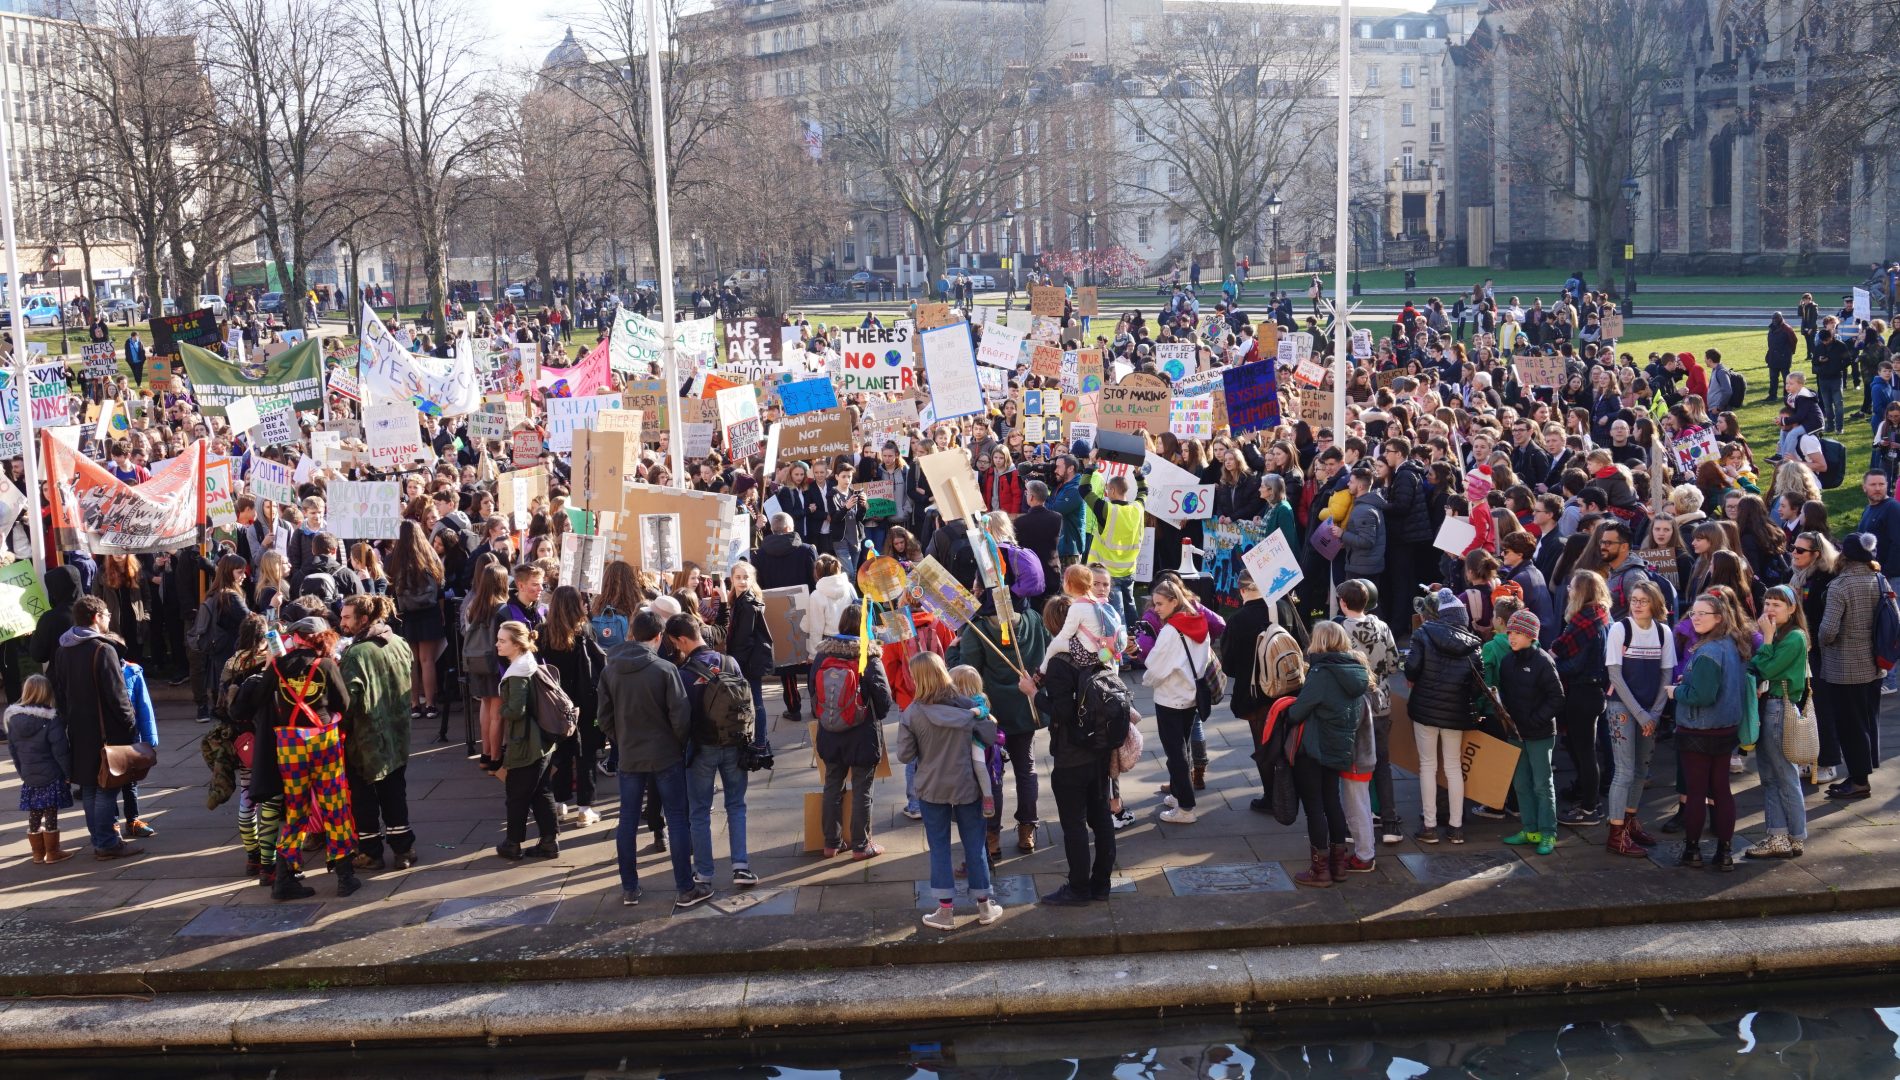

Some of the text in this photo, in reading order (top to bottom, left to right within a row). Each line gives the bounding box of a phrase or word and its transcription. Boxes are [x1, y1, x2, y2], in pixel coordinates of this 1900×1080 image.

[726, 320, 760, 339] WE
[841, 327, 908, 344] THERE'S
[728, 338, 773, 360] ARE
[981, 346, 1015, 361] PROFIT
[1156, 344, 1179, 352] EARTH
[844, 351, 876, 370] NO
[1518, 359, 1544, 369] THERE
[844, 374, 900, 390] PLANET
[1183, 374, 1206, 385] MARCH
[1558, 373, 1567, 384] B
[217, 385, 244, 396] YOUTH
[246, 384, 278, 395] STANDS
[279, 378, 319, 392] TOGETHER
[1103, 388, 1168, 401] STOP MAKING
[1103, 403, 1161, 414] OUR PLANET
[807, 412, 841, 423] CHANGE
[862, 417, 901, 430] PROTECT
[263, 428, 290, 438] FOSSIL
[730, 418, 759, 440] SCIENCE
[798, 428, 823, 441] NOT
[1174, 424, 1209, 434] IS NOW
[268, 435, 289, 444] FOOL
[372, 444, 419, 458] LEAVING
[732, 441, 760, 460] OPINION
[781, 441, 850, 457] CLIMATE CHANGE
[392, 453, 412, 464] US?
[250, 460, 290, 485] YOUTH 4
[250, 477, 289, 503] CHANGE
[328, 482, 373, 502] NOW
[1168, 488, 1209, 515] SOS
[370, 502, 392, 517] OR
[353, 517, 400, 539] NEVER
[111, 532, 152, 547] BRISTOL
[1245, 546, 1265, 564] SAVE
[1639, 549, 1671, 559] CLIMATE
